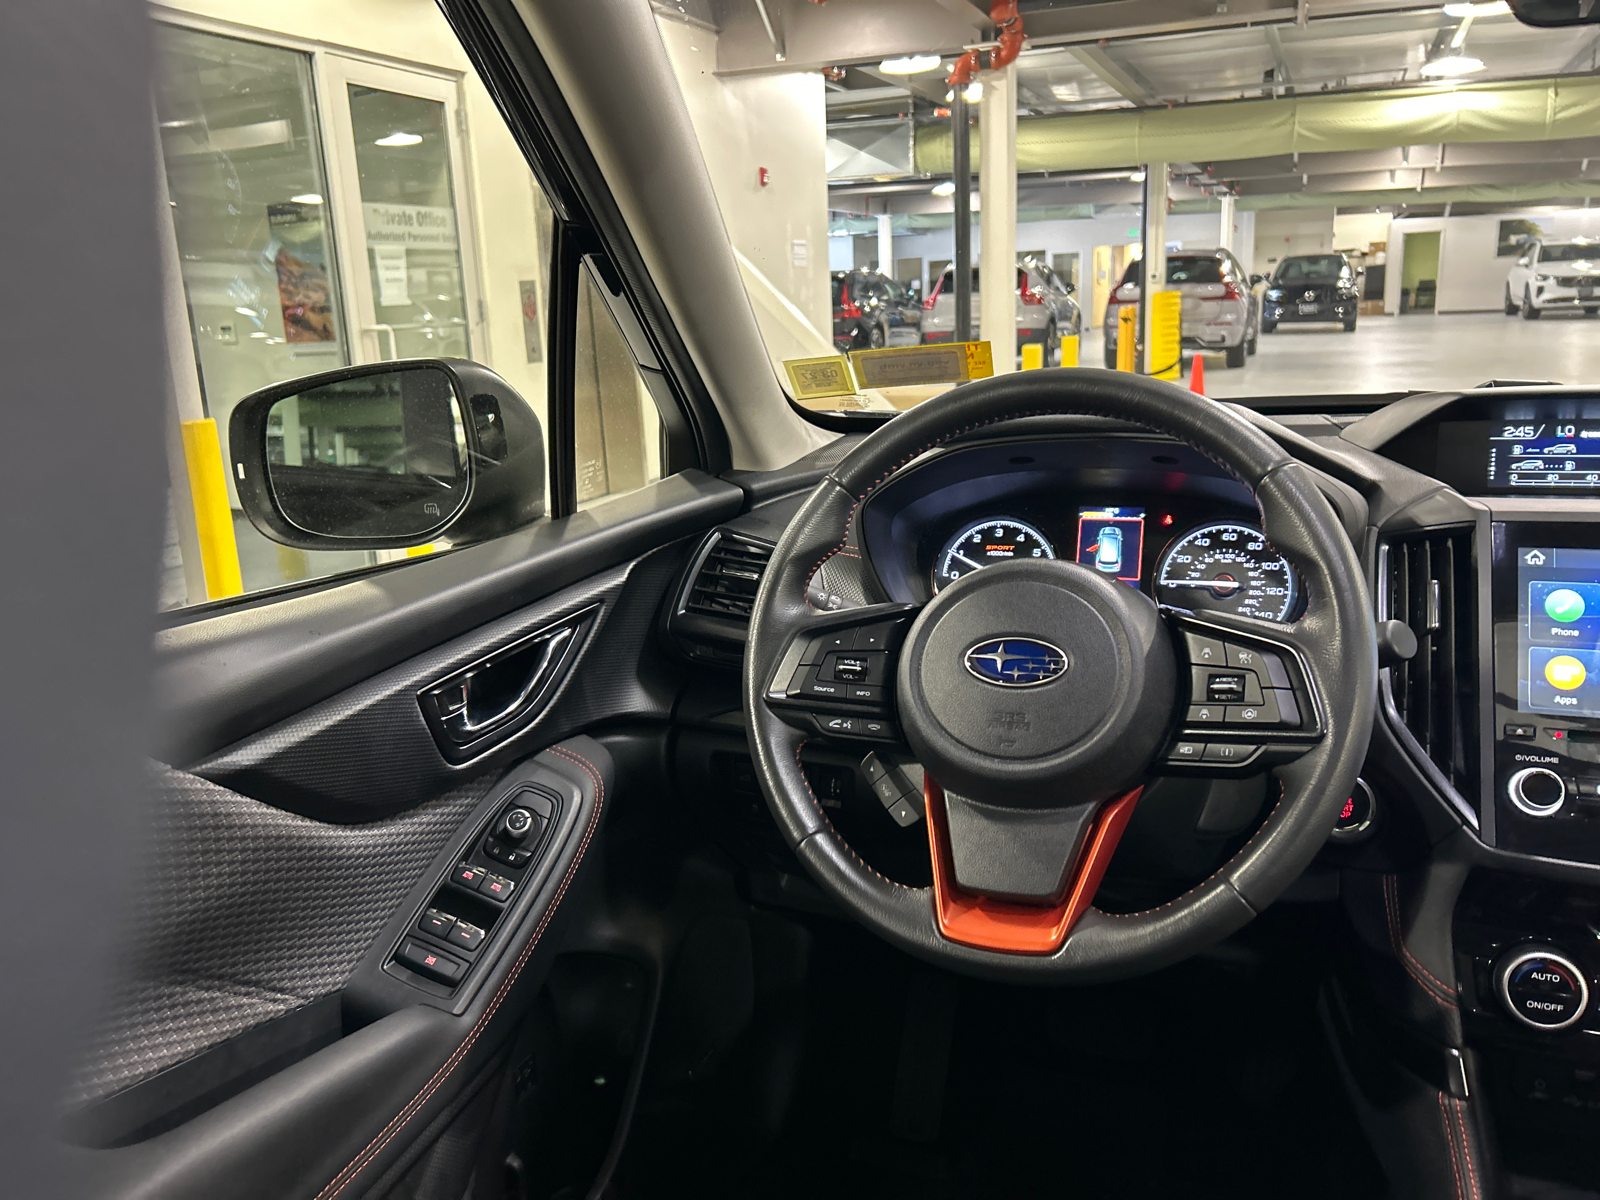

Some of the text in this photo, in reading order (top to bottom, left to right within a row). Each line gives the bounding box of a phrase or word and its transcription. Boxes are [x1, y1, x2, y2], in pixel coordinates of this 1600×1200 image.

[1557, 425, 1575, 436] LO
[995, 528, 1004, 537] 3
[973, 534, 981, 543] 2
[1016, 534, 1025, 542] 4
[1222, 533, 1238, 541] 60
[1194, 538, 1210, 546] 40
[1247, 542, 1263, 550] 80
[1032, 548, 1041, 557] 5
[1177, 555, 1191, 563] 20
[1261, 562, 1280, 570] 100
[950, 571, 959, 579] 0
[1266, 587, 1284, 595] 120
[1551, 627, 1579, 637] Phone
[813, 685, 835, 693] Source
[1554, 695, 1578, 706] Apps
[1531, 971, 1560, 983] AUTO
[1526, 1000, 1564, 1012] ON/OFF
